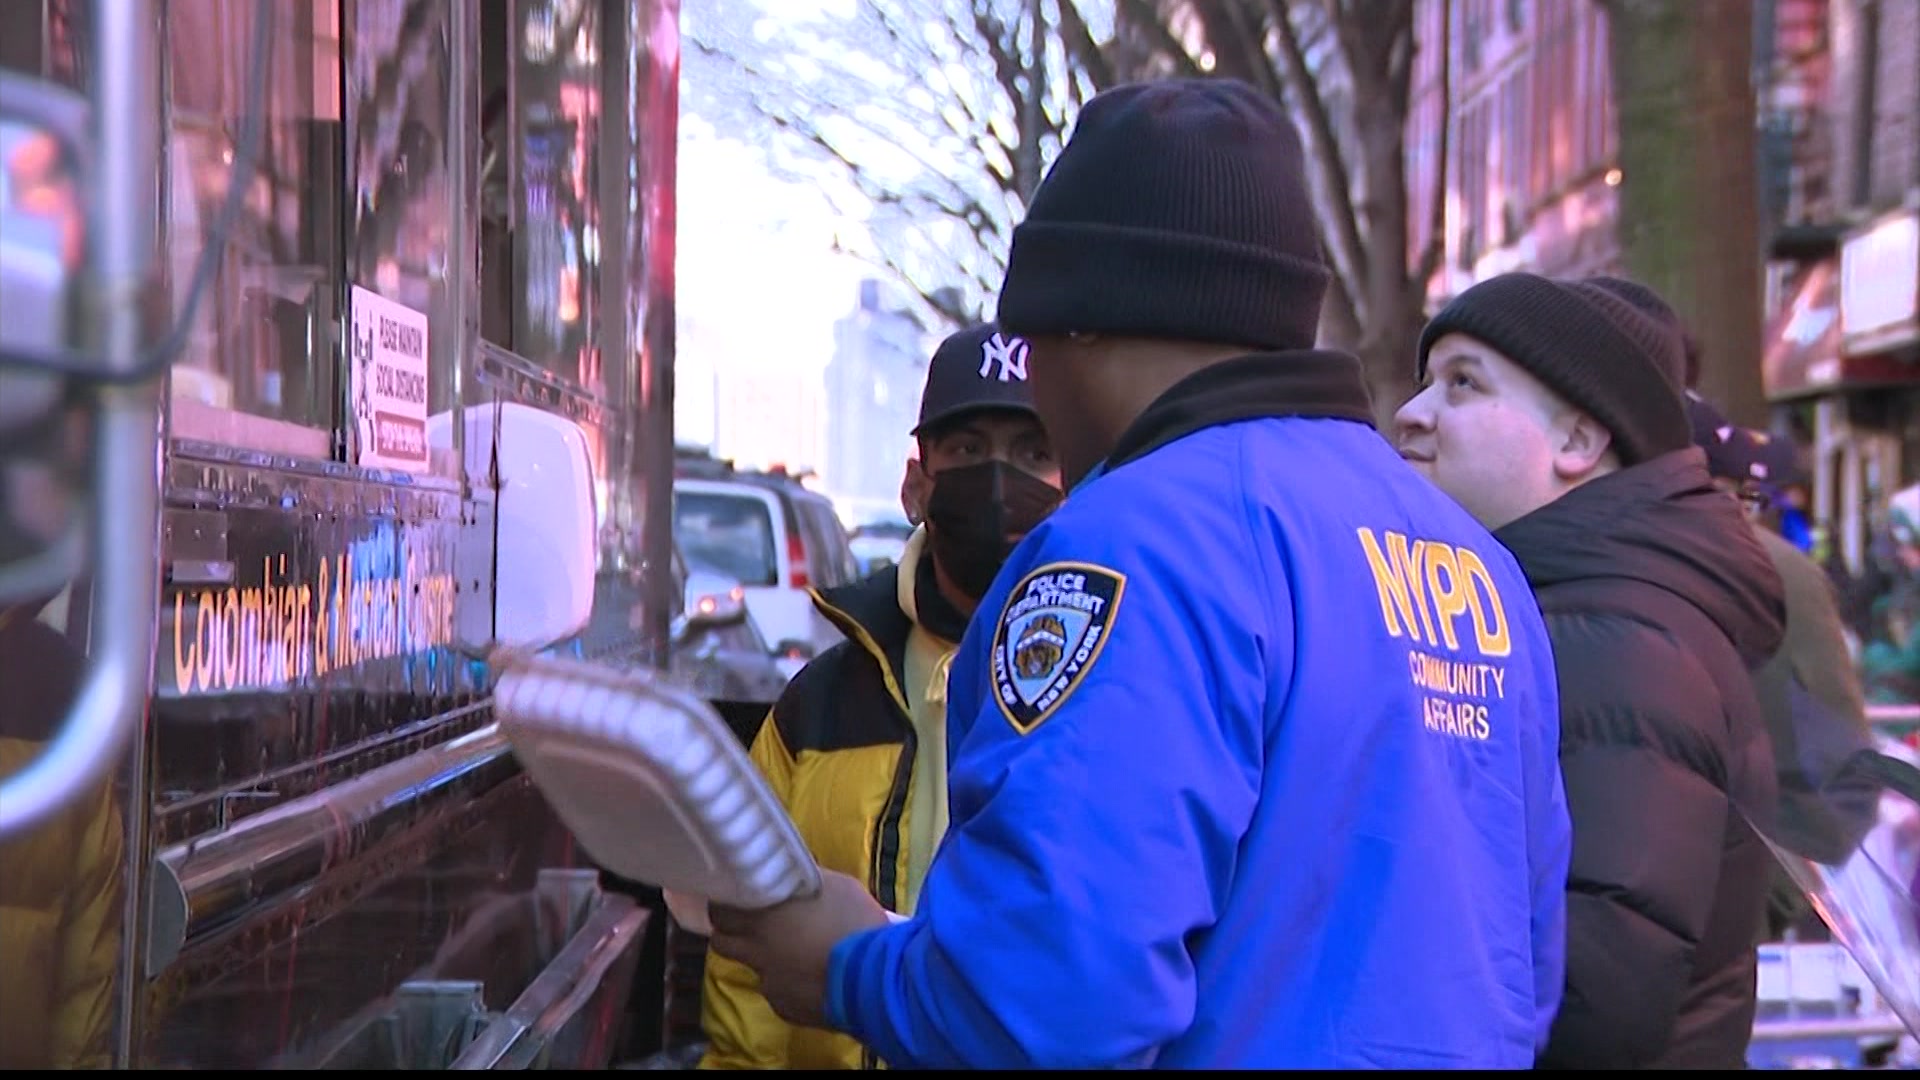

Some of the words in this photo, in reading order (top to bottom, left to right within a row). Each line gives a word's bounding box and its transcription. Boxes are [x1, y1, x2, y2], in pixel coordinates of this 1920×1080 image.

[1005, 590, 1105, 623] DEPARTMENT
[1026, 573, 1086, 597] POLICE
[1356, 526, 1512, 657] NYPD
[173, 552, 311, 696] Colombian
[315, 554, 331, 678] &
[333, 552, 401, 671] Mexican
[1065, 625, 1103, 673] YORK
[1407, 649, 1506, 699] COMMUNITY
[1423, 695, 1491, 741] AFFAIRS
